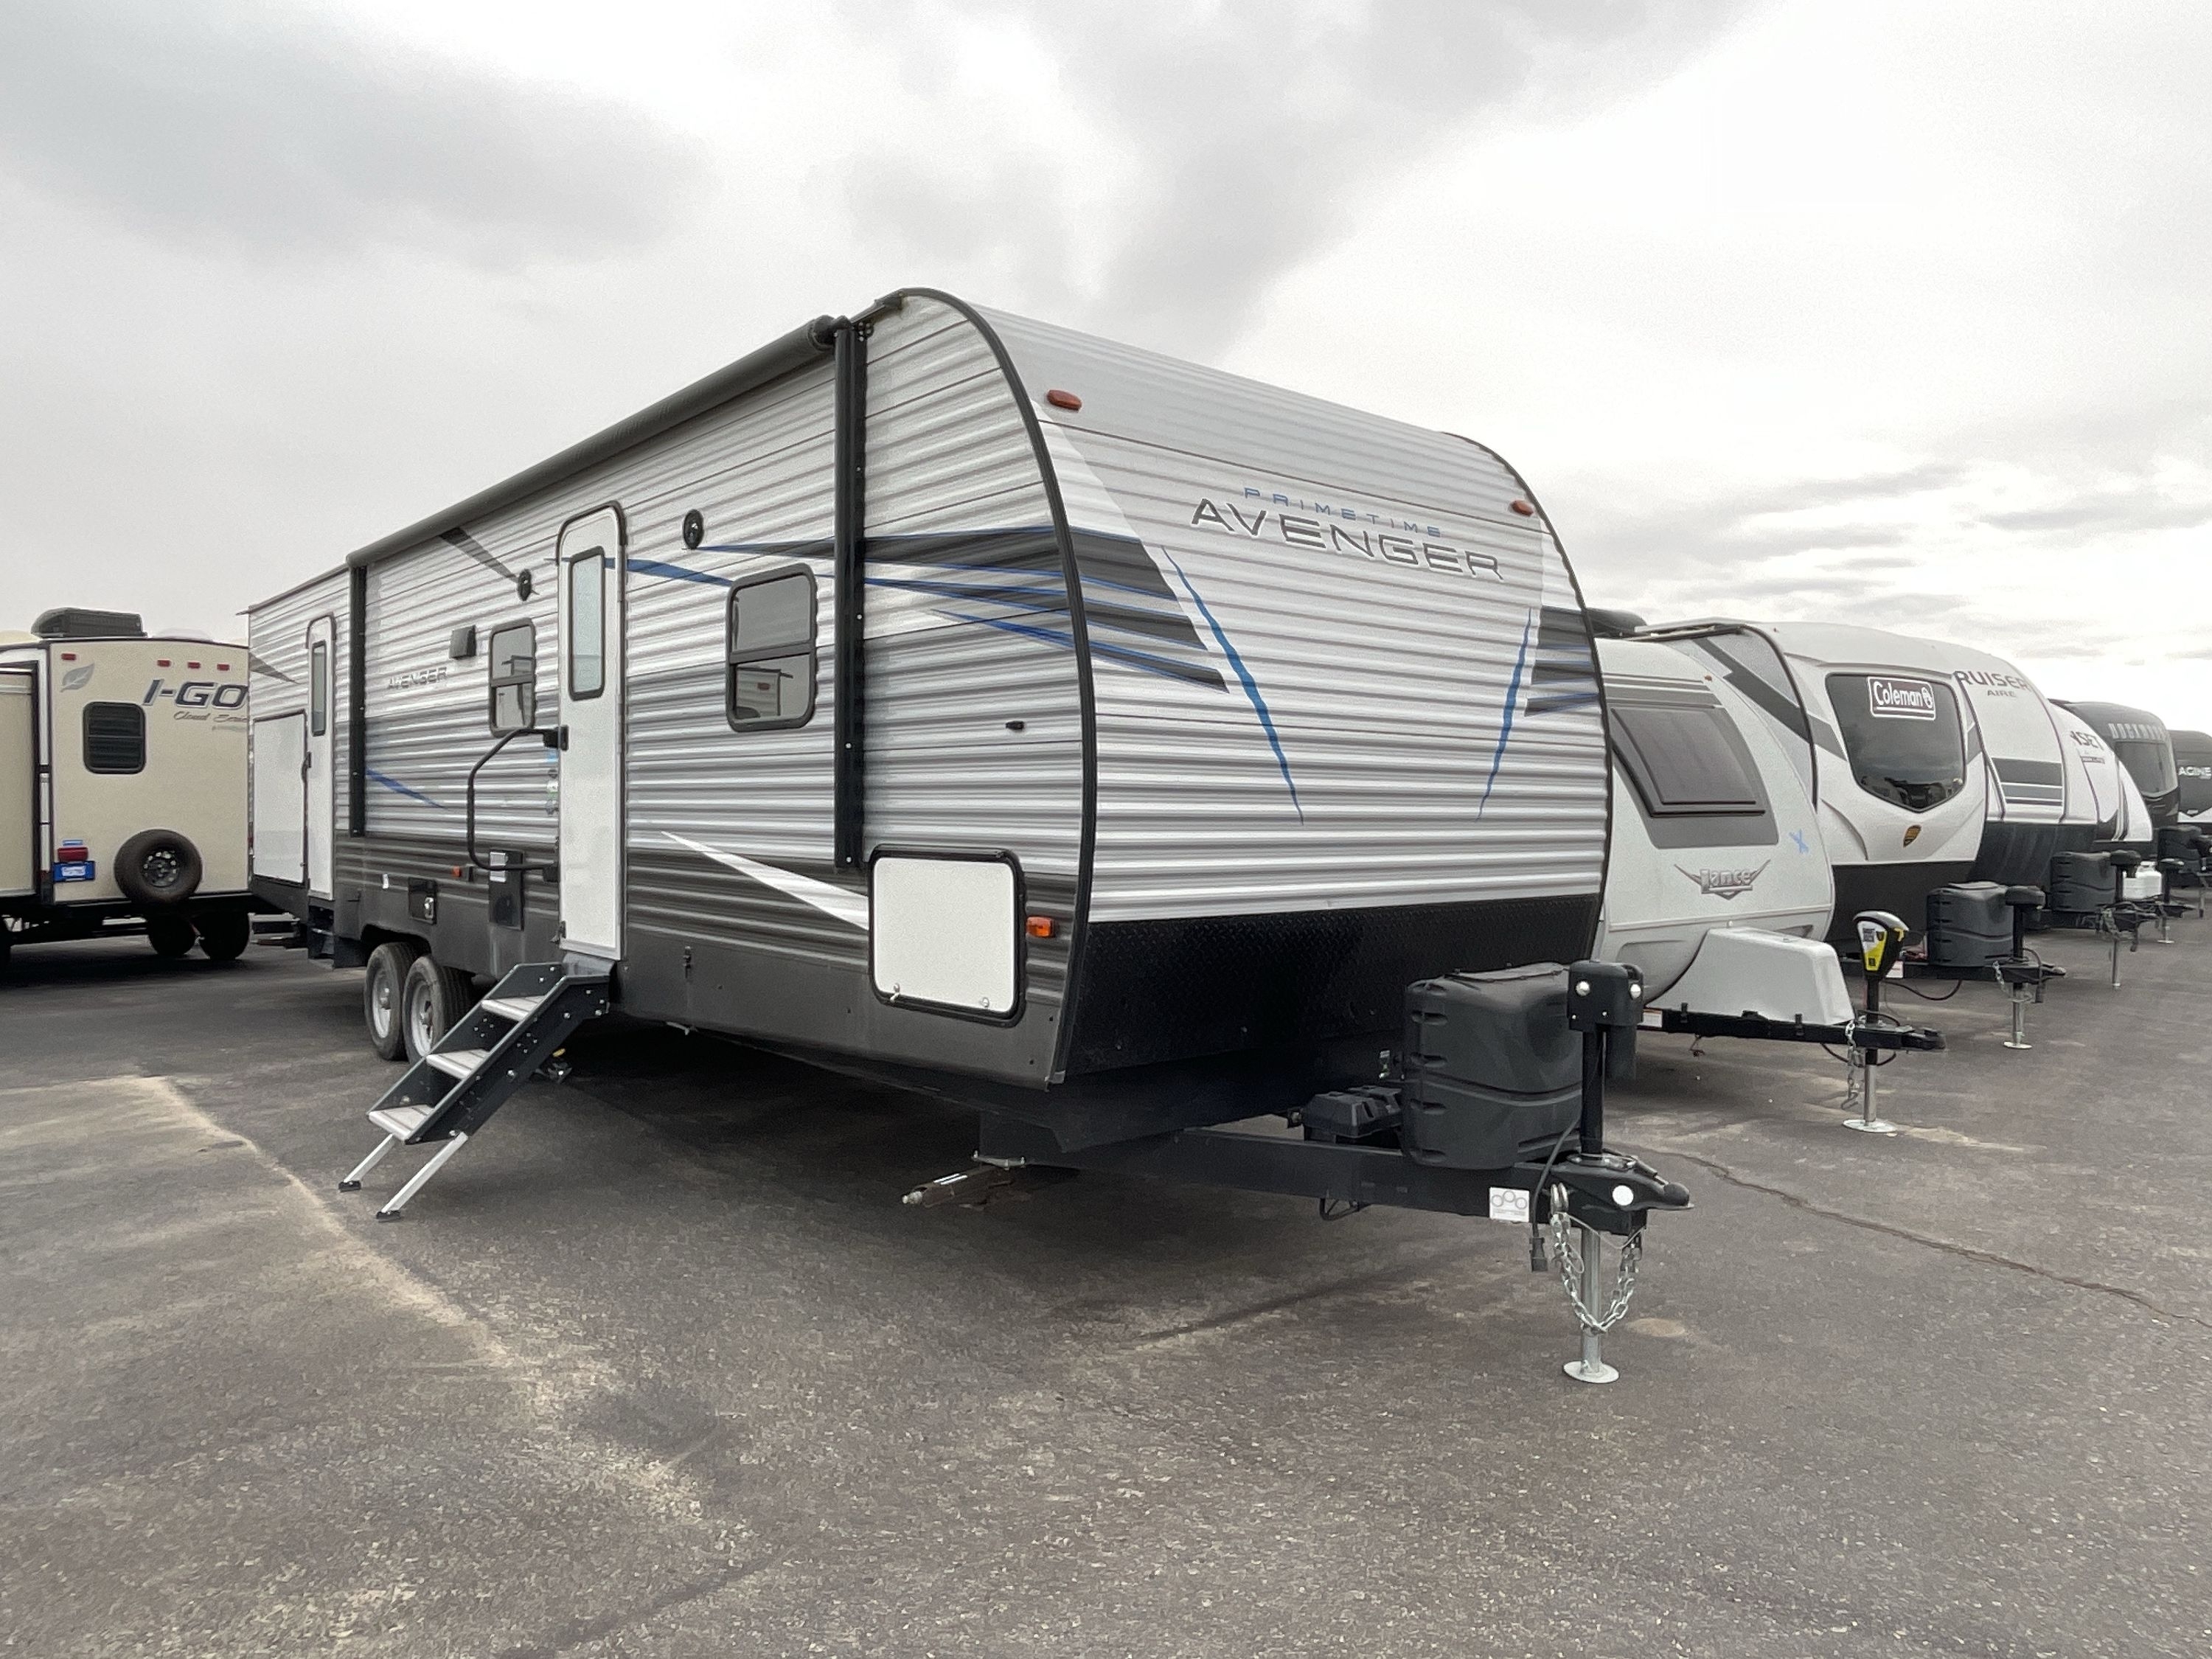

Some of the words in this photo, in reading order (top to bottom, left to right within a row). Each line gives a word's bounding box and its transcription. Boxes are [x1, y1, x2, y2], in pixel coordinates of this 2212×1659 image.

[1243, 487, 1441, 538] PRIMETIME
[1191, 497, 1505, 581] AVENGER
[142, 678, 249, 709] I-GO
[1873, 681, 1924, 706] Coleman
[1953, 670, 2032, 692] RUISER
